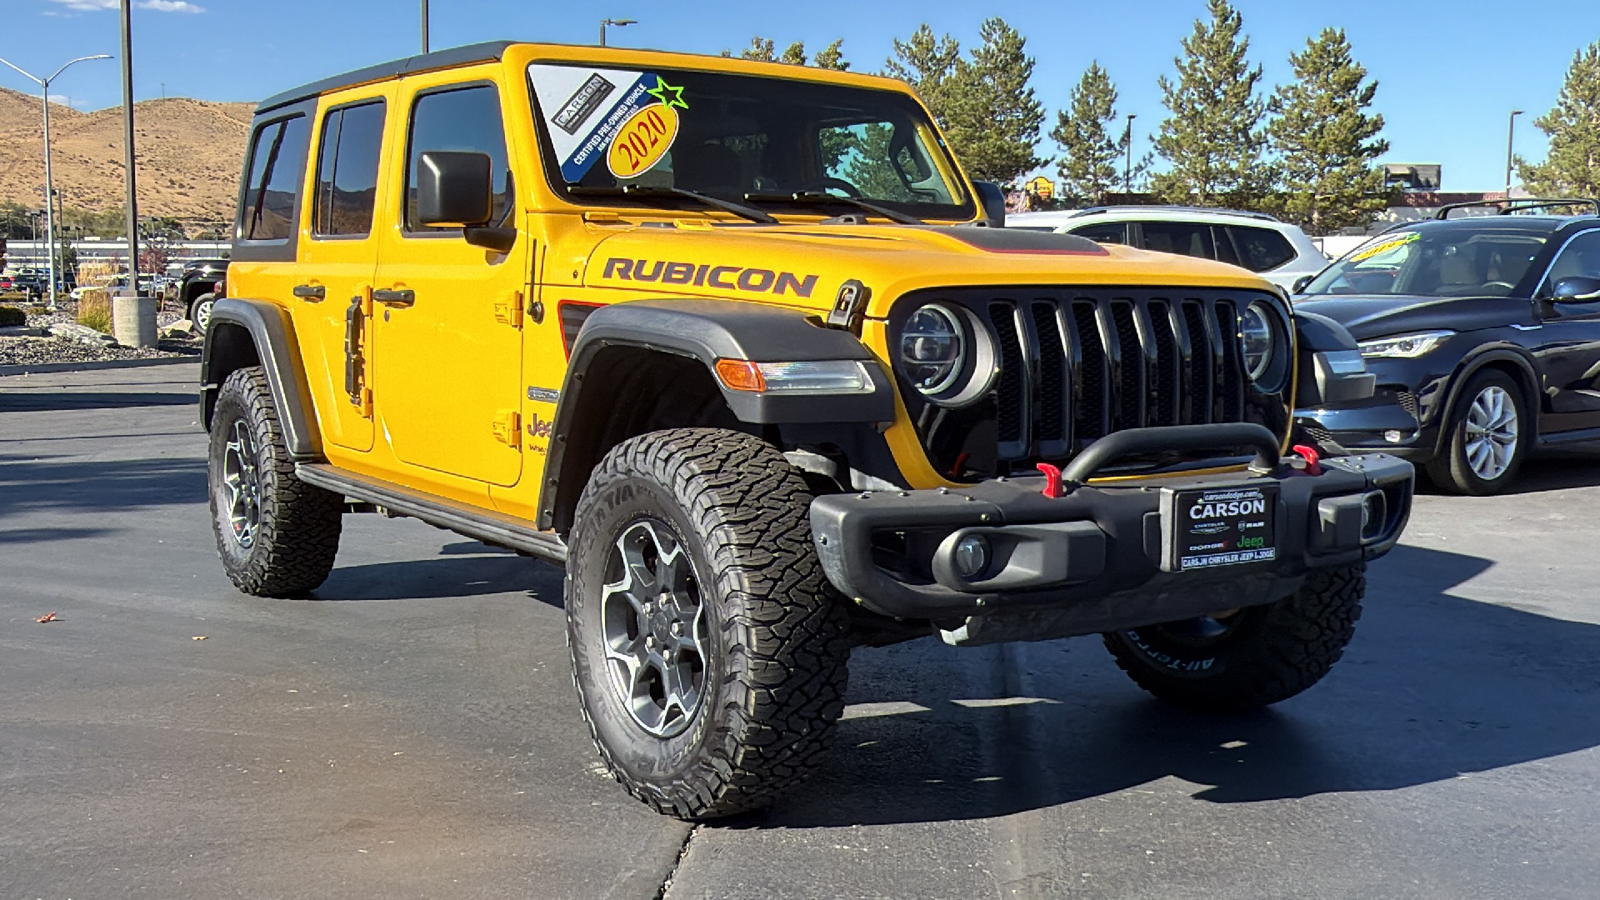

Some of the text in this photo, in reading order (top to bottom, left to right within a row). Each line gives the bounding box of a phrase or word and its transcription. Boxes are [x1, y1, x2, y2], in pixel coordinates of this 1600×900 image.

[557, 76, 602, 125] CARSON
[573, 134, 601, 166] CERTIFIED
[597, 102, 629, 140] PRE-OWNED
[625, 82, 648, 109] VEHICLE
[618, 109, 667, 171] 2020
[602, 257, 820, 298] RUBICON
[1189, 499, 1265, 519] CARSON
[1189, 542, 1224, 551] DODGE
[1236, 535, 1264, 549] Jeep
[1208, 554, 1239, 565] CHRYSLER
[1239, 552, 1254, 561] JEEP
